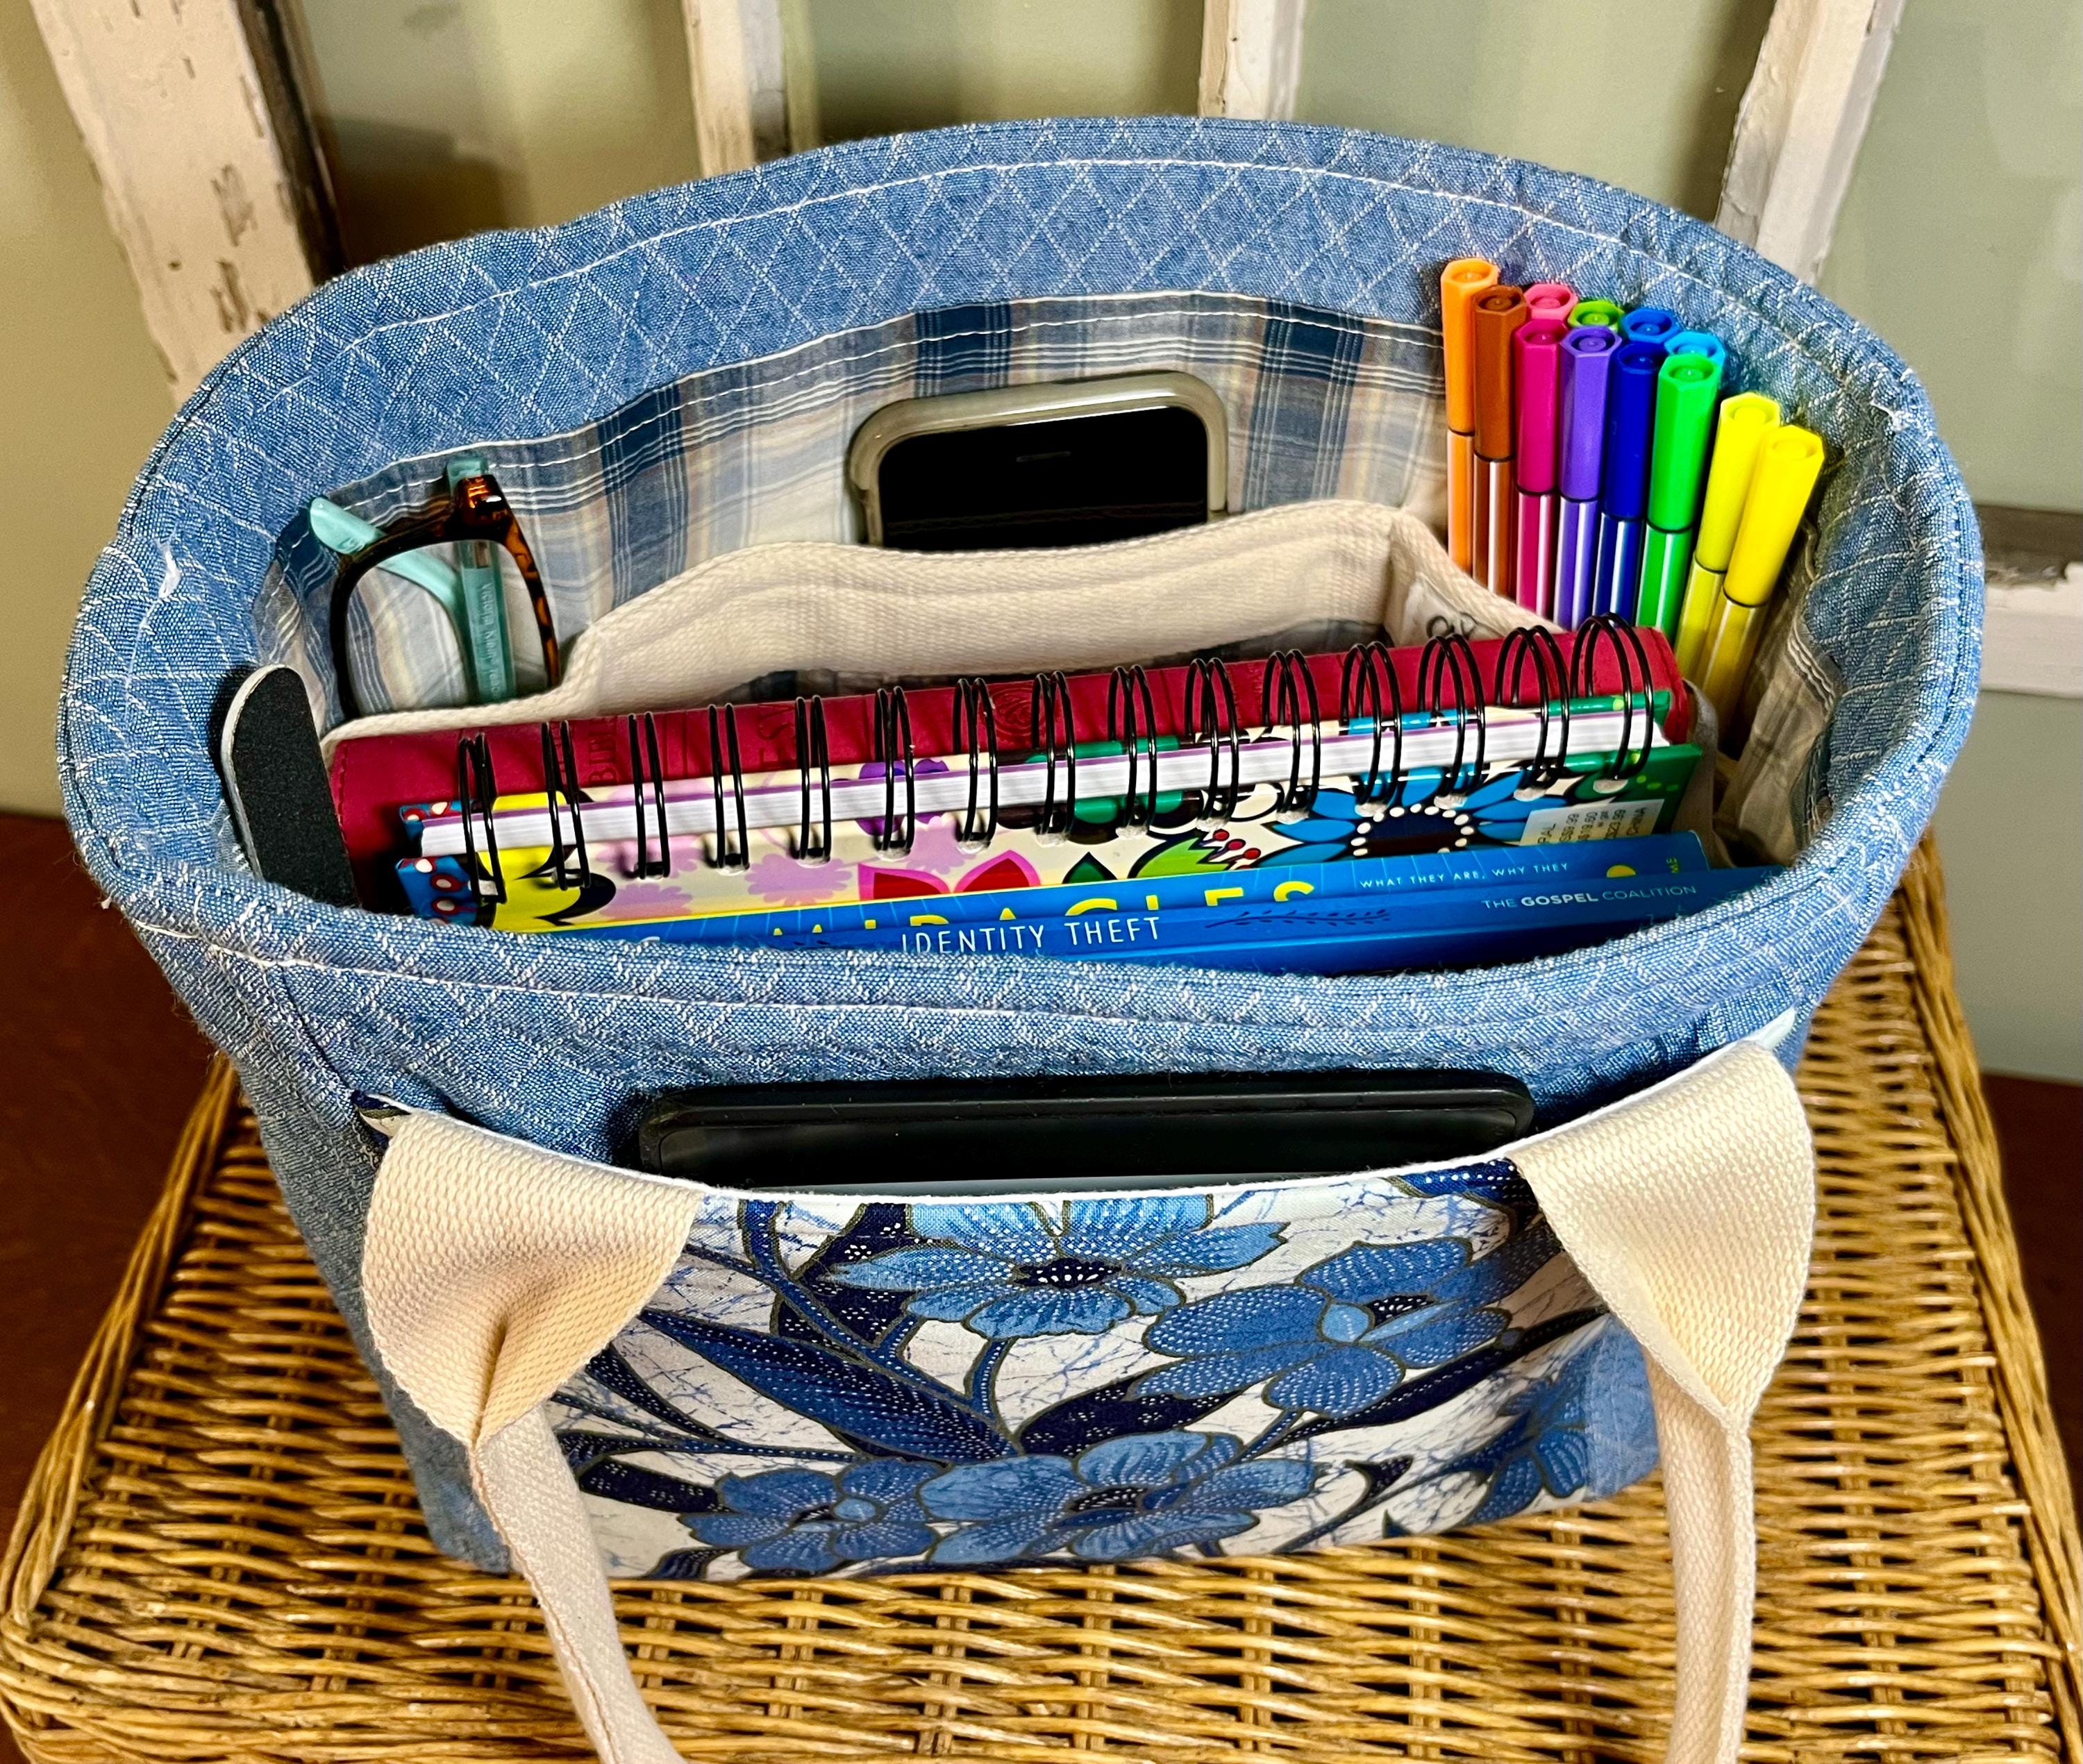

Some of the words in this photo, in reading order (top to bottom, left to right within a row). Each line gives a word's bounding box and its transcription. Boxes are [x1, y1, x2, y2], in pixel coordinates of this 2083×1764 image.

[1360, 876, 1402, 888] WHAT
[1410, 873, 1445, 884] THEY
[1453, 870, 1485, 881] ARE,
[1491, 866, 1525, 877] WHY
[1533, 862, 1568, 873] THEY
[1482, 898, 1518, 910] THE
[1521, 892, 1599, 907] GOSPEL
[1602, 885, 1697, 900] COALITION
[902, 925, 1044, 954] IDENTITY
[1064, 916, 1160, 946] THEFT
